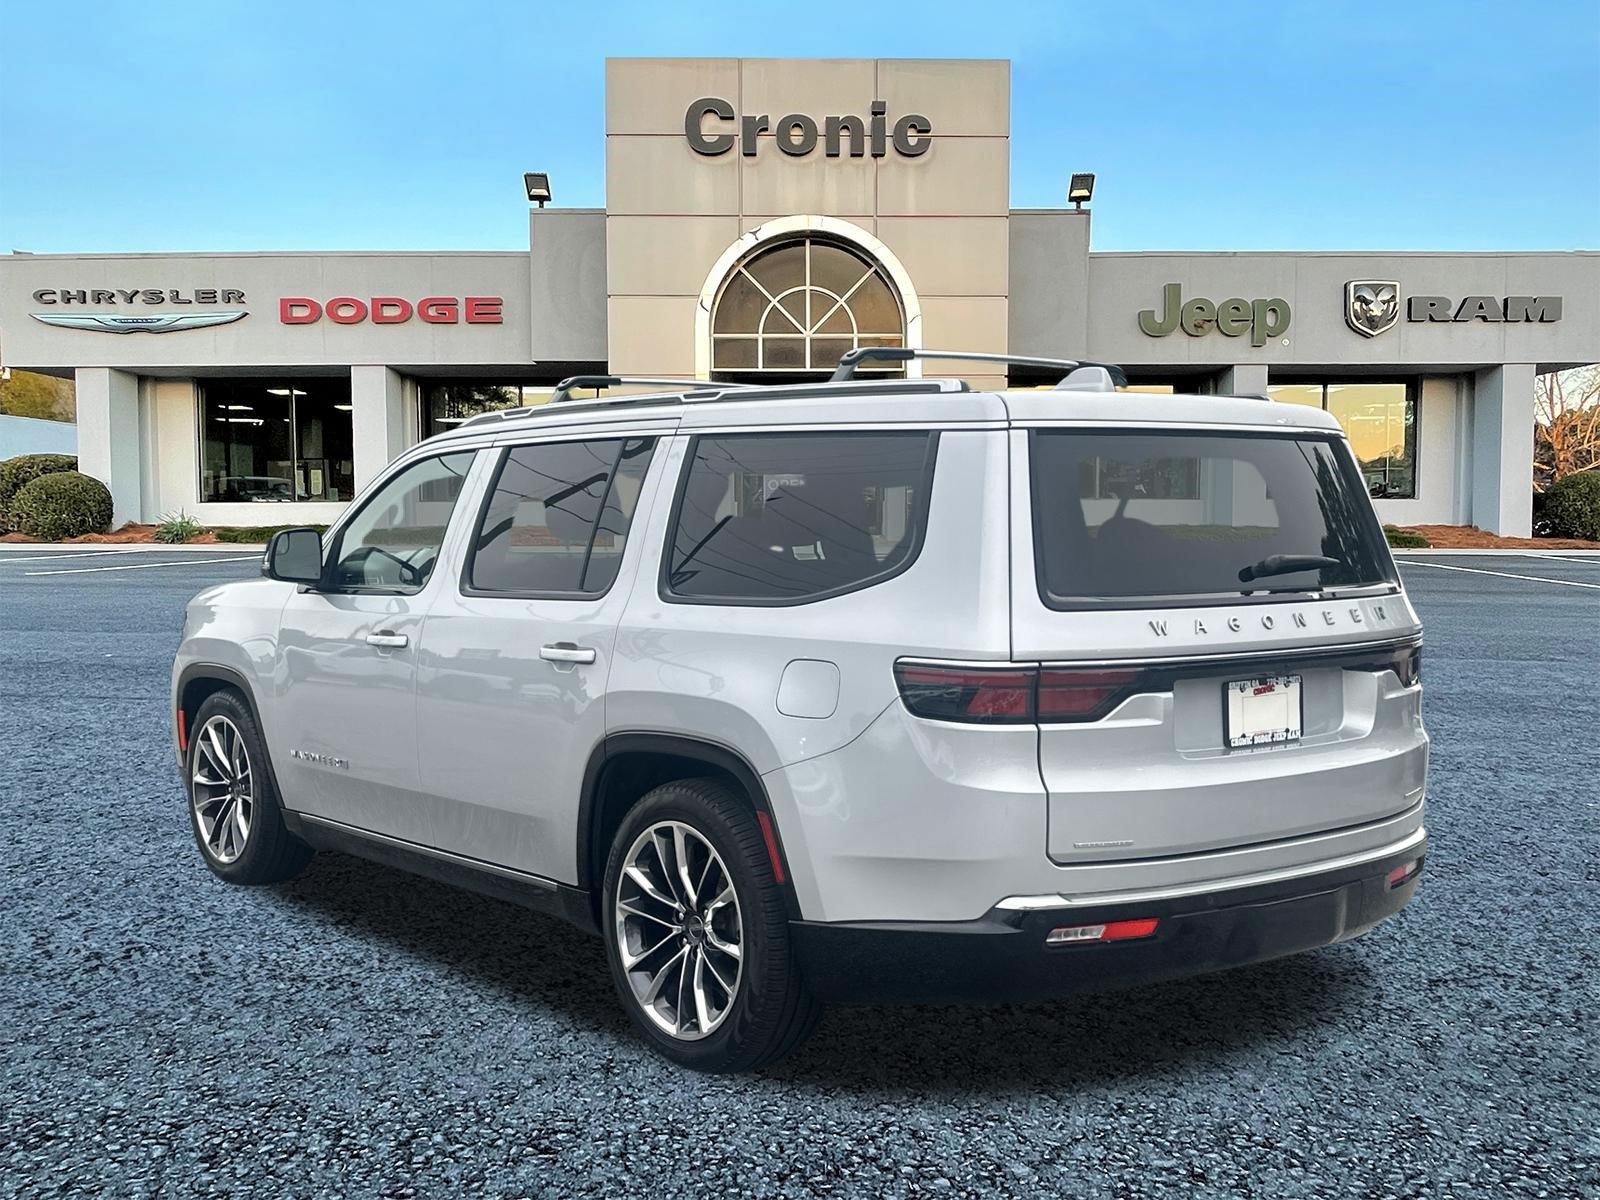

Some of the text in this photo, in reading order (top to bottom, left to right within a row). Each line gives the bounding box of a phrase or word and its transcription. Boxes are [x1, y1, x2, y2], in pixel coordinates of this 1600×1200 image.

[684, 97, 932, 157] Cronic
[32, 289, 247, 305] CHRYSLER
[279, 297, 504, 324] DODGE
[1407, 296, 1563, 322] RAM
[1138, 283, 1292, 347] Jeep
[1149, 606, 1388, 637] WAGONEER
